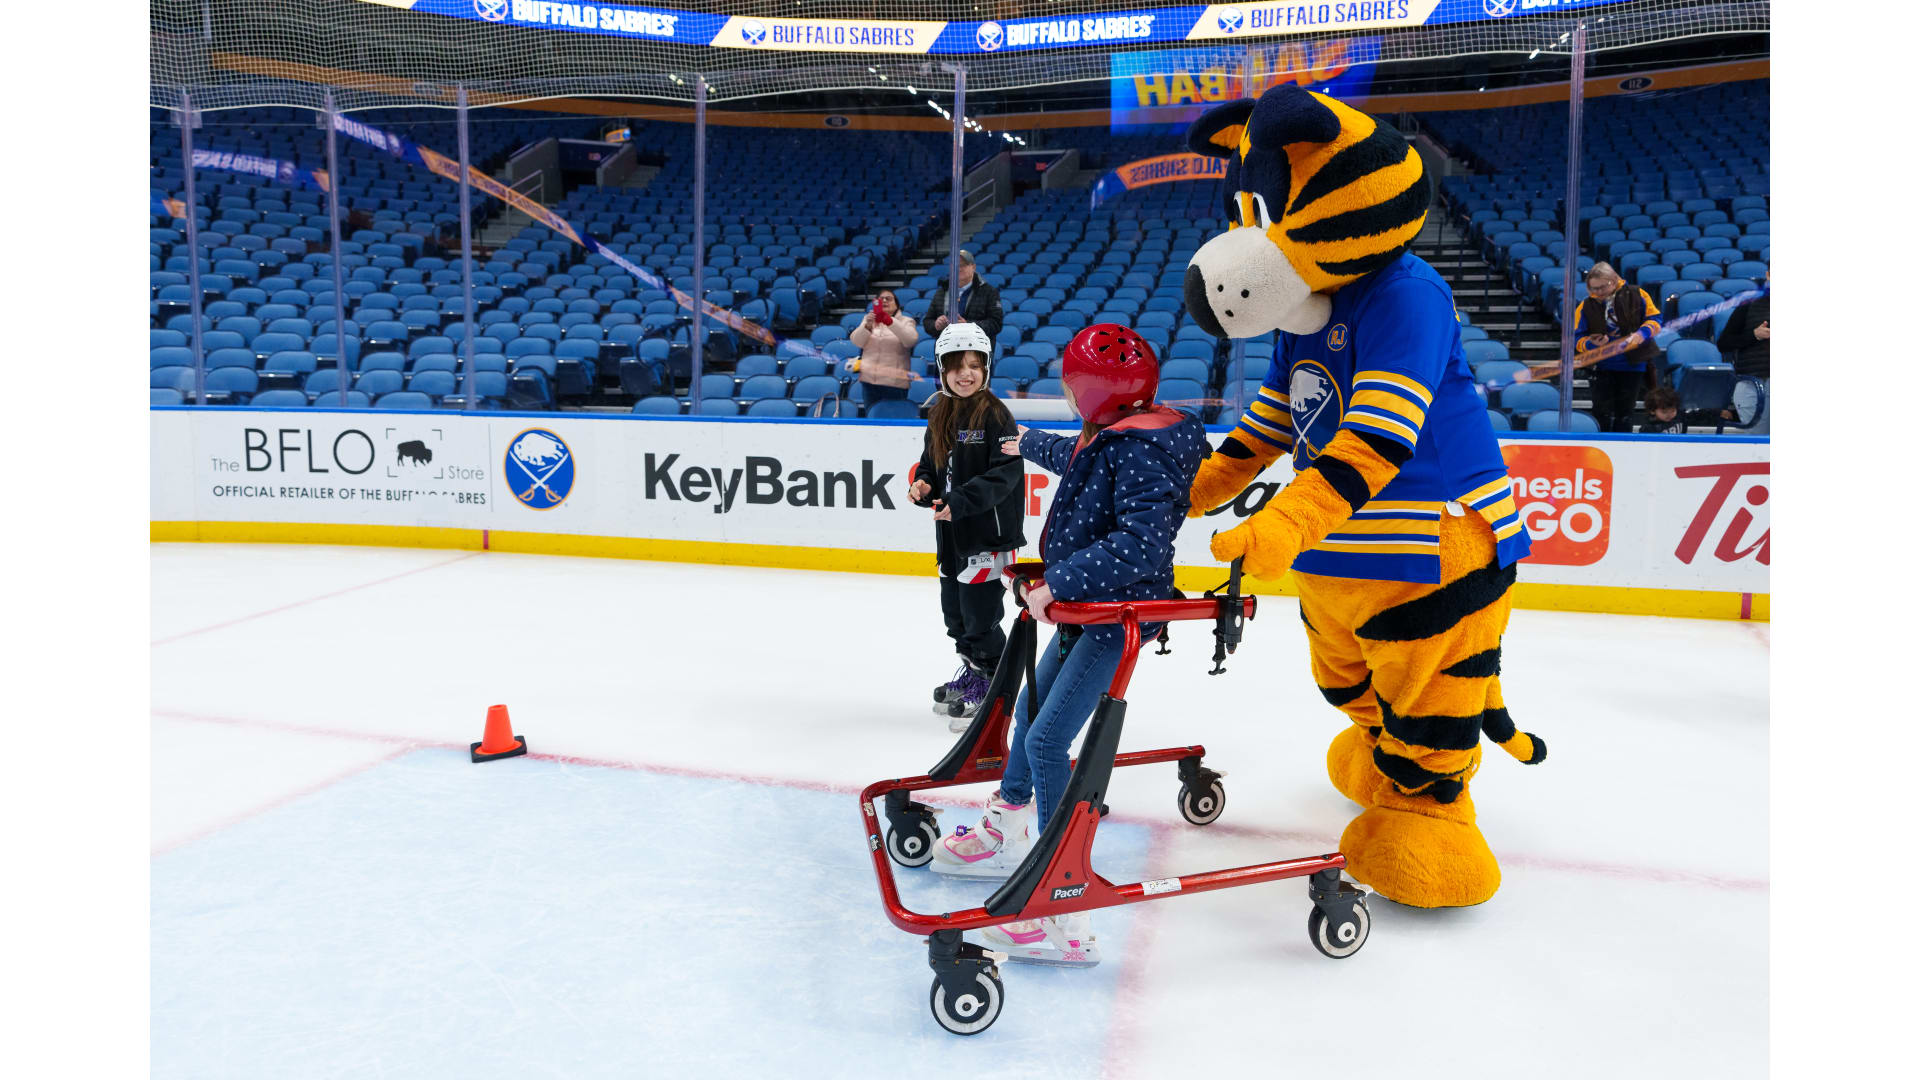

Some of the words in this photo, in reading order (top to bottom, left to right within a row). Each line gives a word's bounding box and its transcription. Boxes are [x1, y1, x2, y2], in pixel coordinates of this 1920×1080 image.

[512, 0, 598, 29] BUFFALO
[600, 8, 675, 36] SABRES
[1007, 20, 1080, 46] BUFFALO
[1082, 15, 1151, 41] SABRES
[1251, 5, 1329, 28] BUFFALO
[1335, 0, 1409, 22] SABRES
[773, 25, 845, 44] BUFFALO
[850, 27, 914, 46] SABRES
[211, 457, 240, 473] The
[244, 427, 375, 475] BFLO
[448, 465, 485, 480] Store
[213, 485, 275, 498] OFFICIAL
[280, 486, 334, 499] RETAILER
[339, 488, 356, 499] OF
[360, 488, 381, 500] THE
[644, 452, 897, 514] KeyBank
[1519, 501, 1603, 543] GO
[1674, 461, 1770, 566] Ti
[1053, 886, 1085, 900] Pacer
